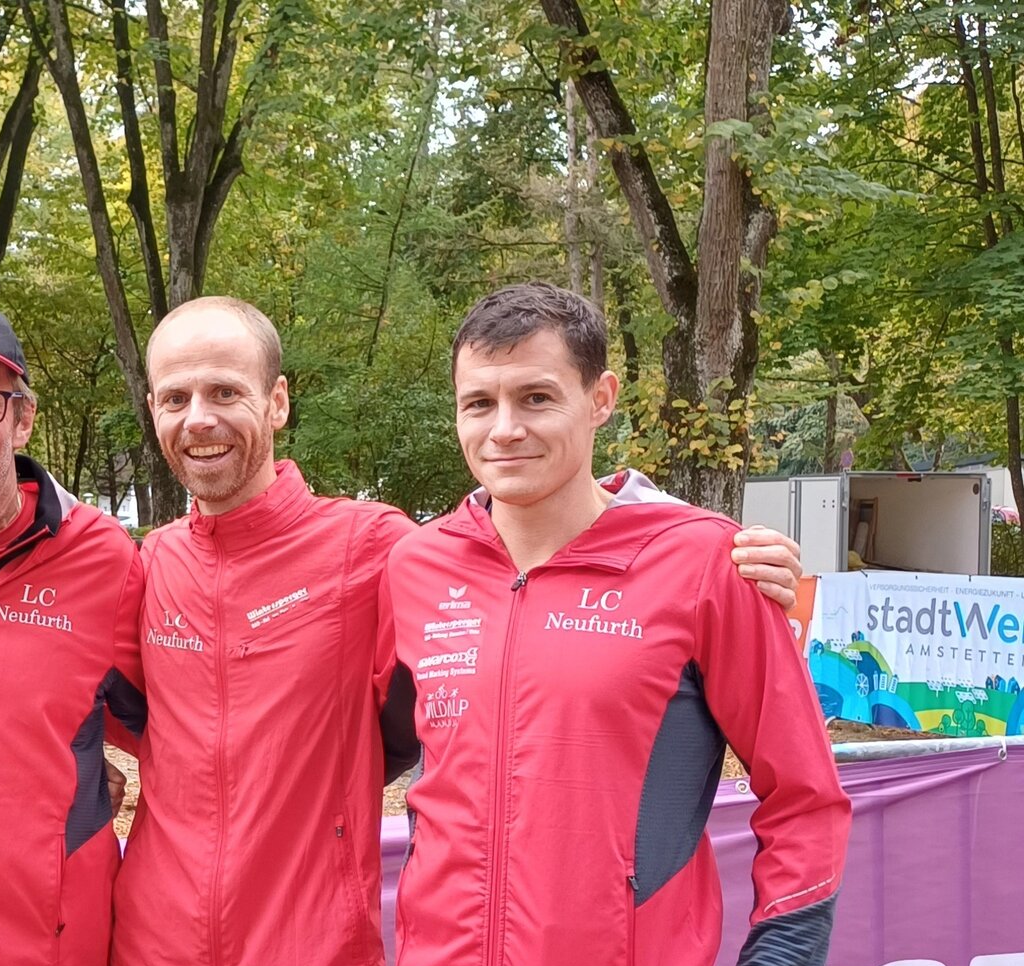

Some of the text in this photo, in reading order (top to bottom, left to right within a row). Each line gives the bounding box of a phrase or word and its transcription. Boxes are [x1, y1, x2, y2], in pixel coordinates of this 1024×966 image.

[20, 584, 57, 607] LC
[577, 587, 623, 611] LC
[955, 586, 1015, 599] ENERGIEZUKUNFT
[163, 609, 189, 629] LC
[544, 612, 643, 639] Neufurth
[866, 596, 1024, 644] stadtWe
[146, 628, 204, 652] Neufurth
[905, 643, 1024, 666] AMSTETTE
